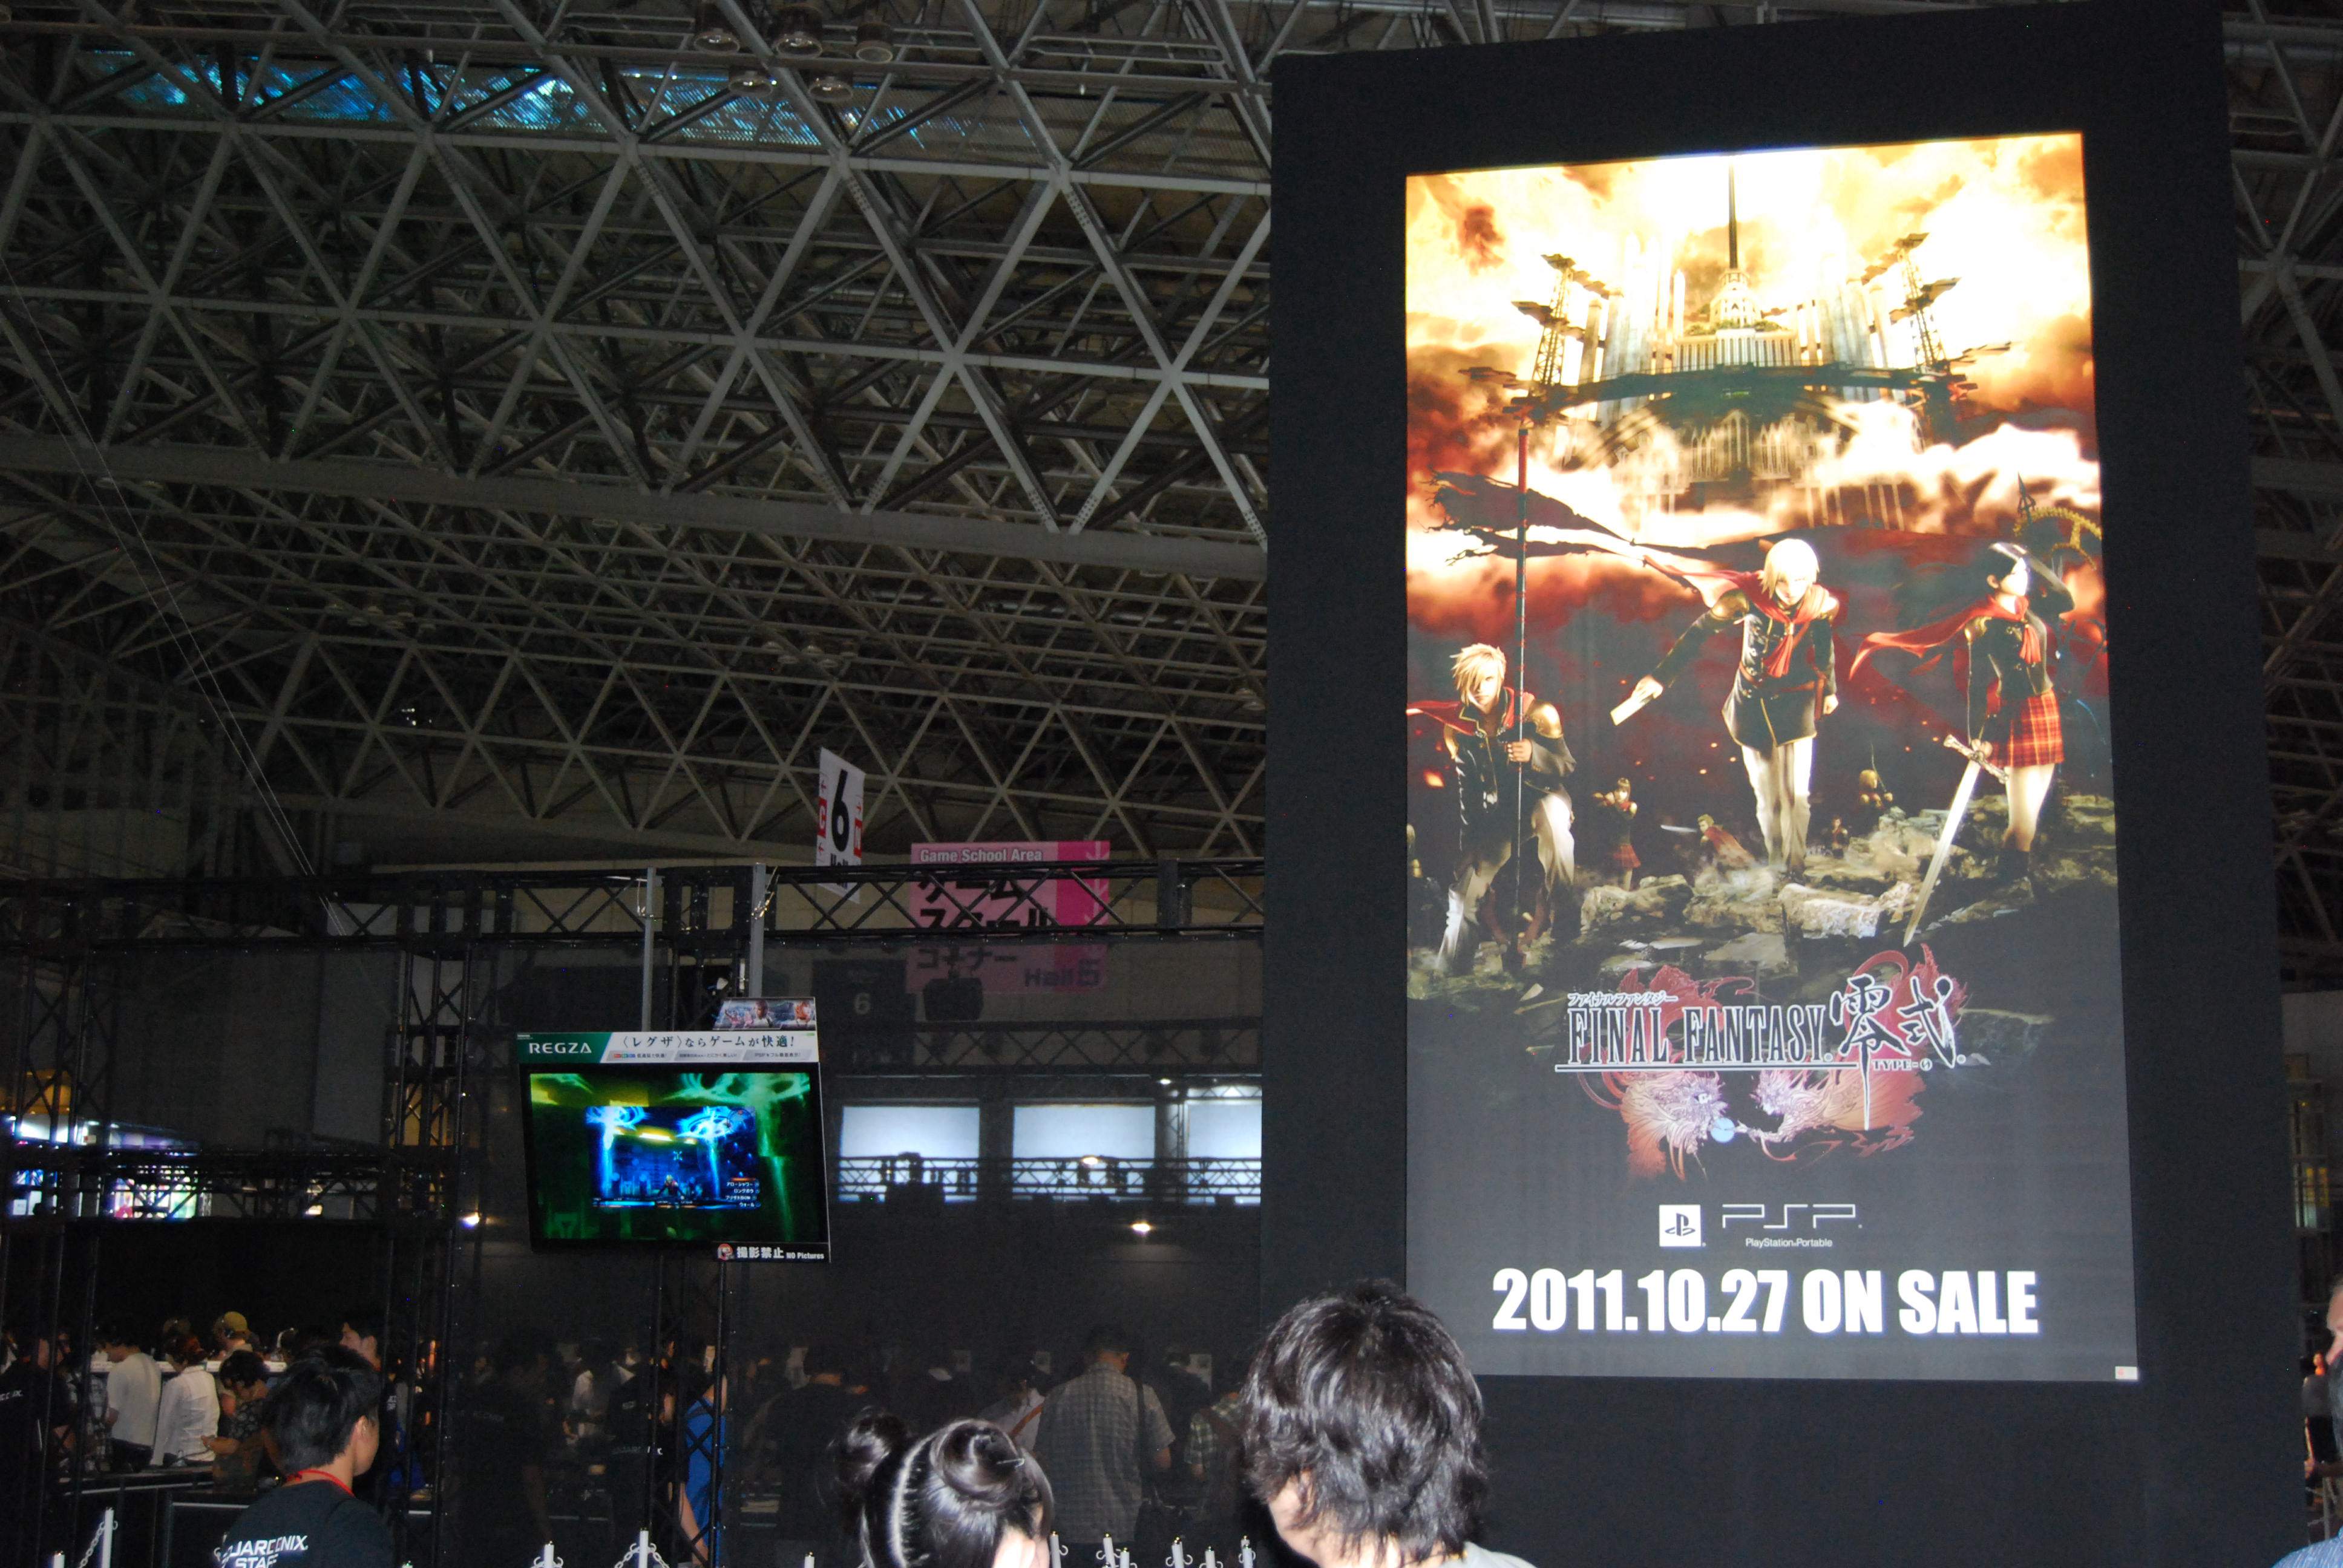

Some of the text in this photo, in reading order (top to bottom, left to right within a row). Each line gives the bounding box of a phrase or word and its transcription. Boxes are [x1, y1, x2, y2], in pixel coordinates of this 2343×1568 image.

[831, 769, 849, 852] 6
[920, 848, 1043, 863] Game School Area
[853, 991, 872, 1016] 6
[1567, 990, 1679, 1007] ファイナルファンタジー
[528, 1042, 592, 1054] REGZA
[1567, 974, 1957, 1131] FINAL FANTASY 零式
[1722, 1204, 1856, 1229] PSP
[736, 1246, 784, 1259] 撮影禁止
[1492, 1268, 2039, 1334] 2011.10.27 ON SALE
